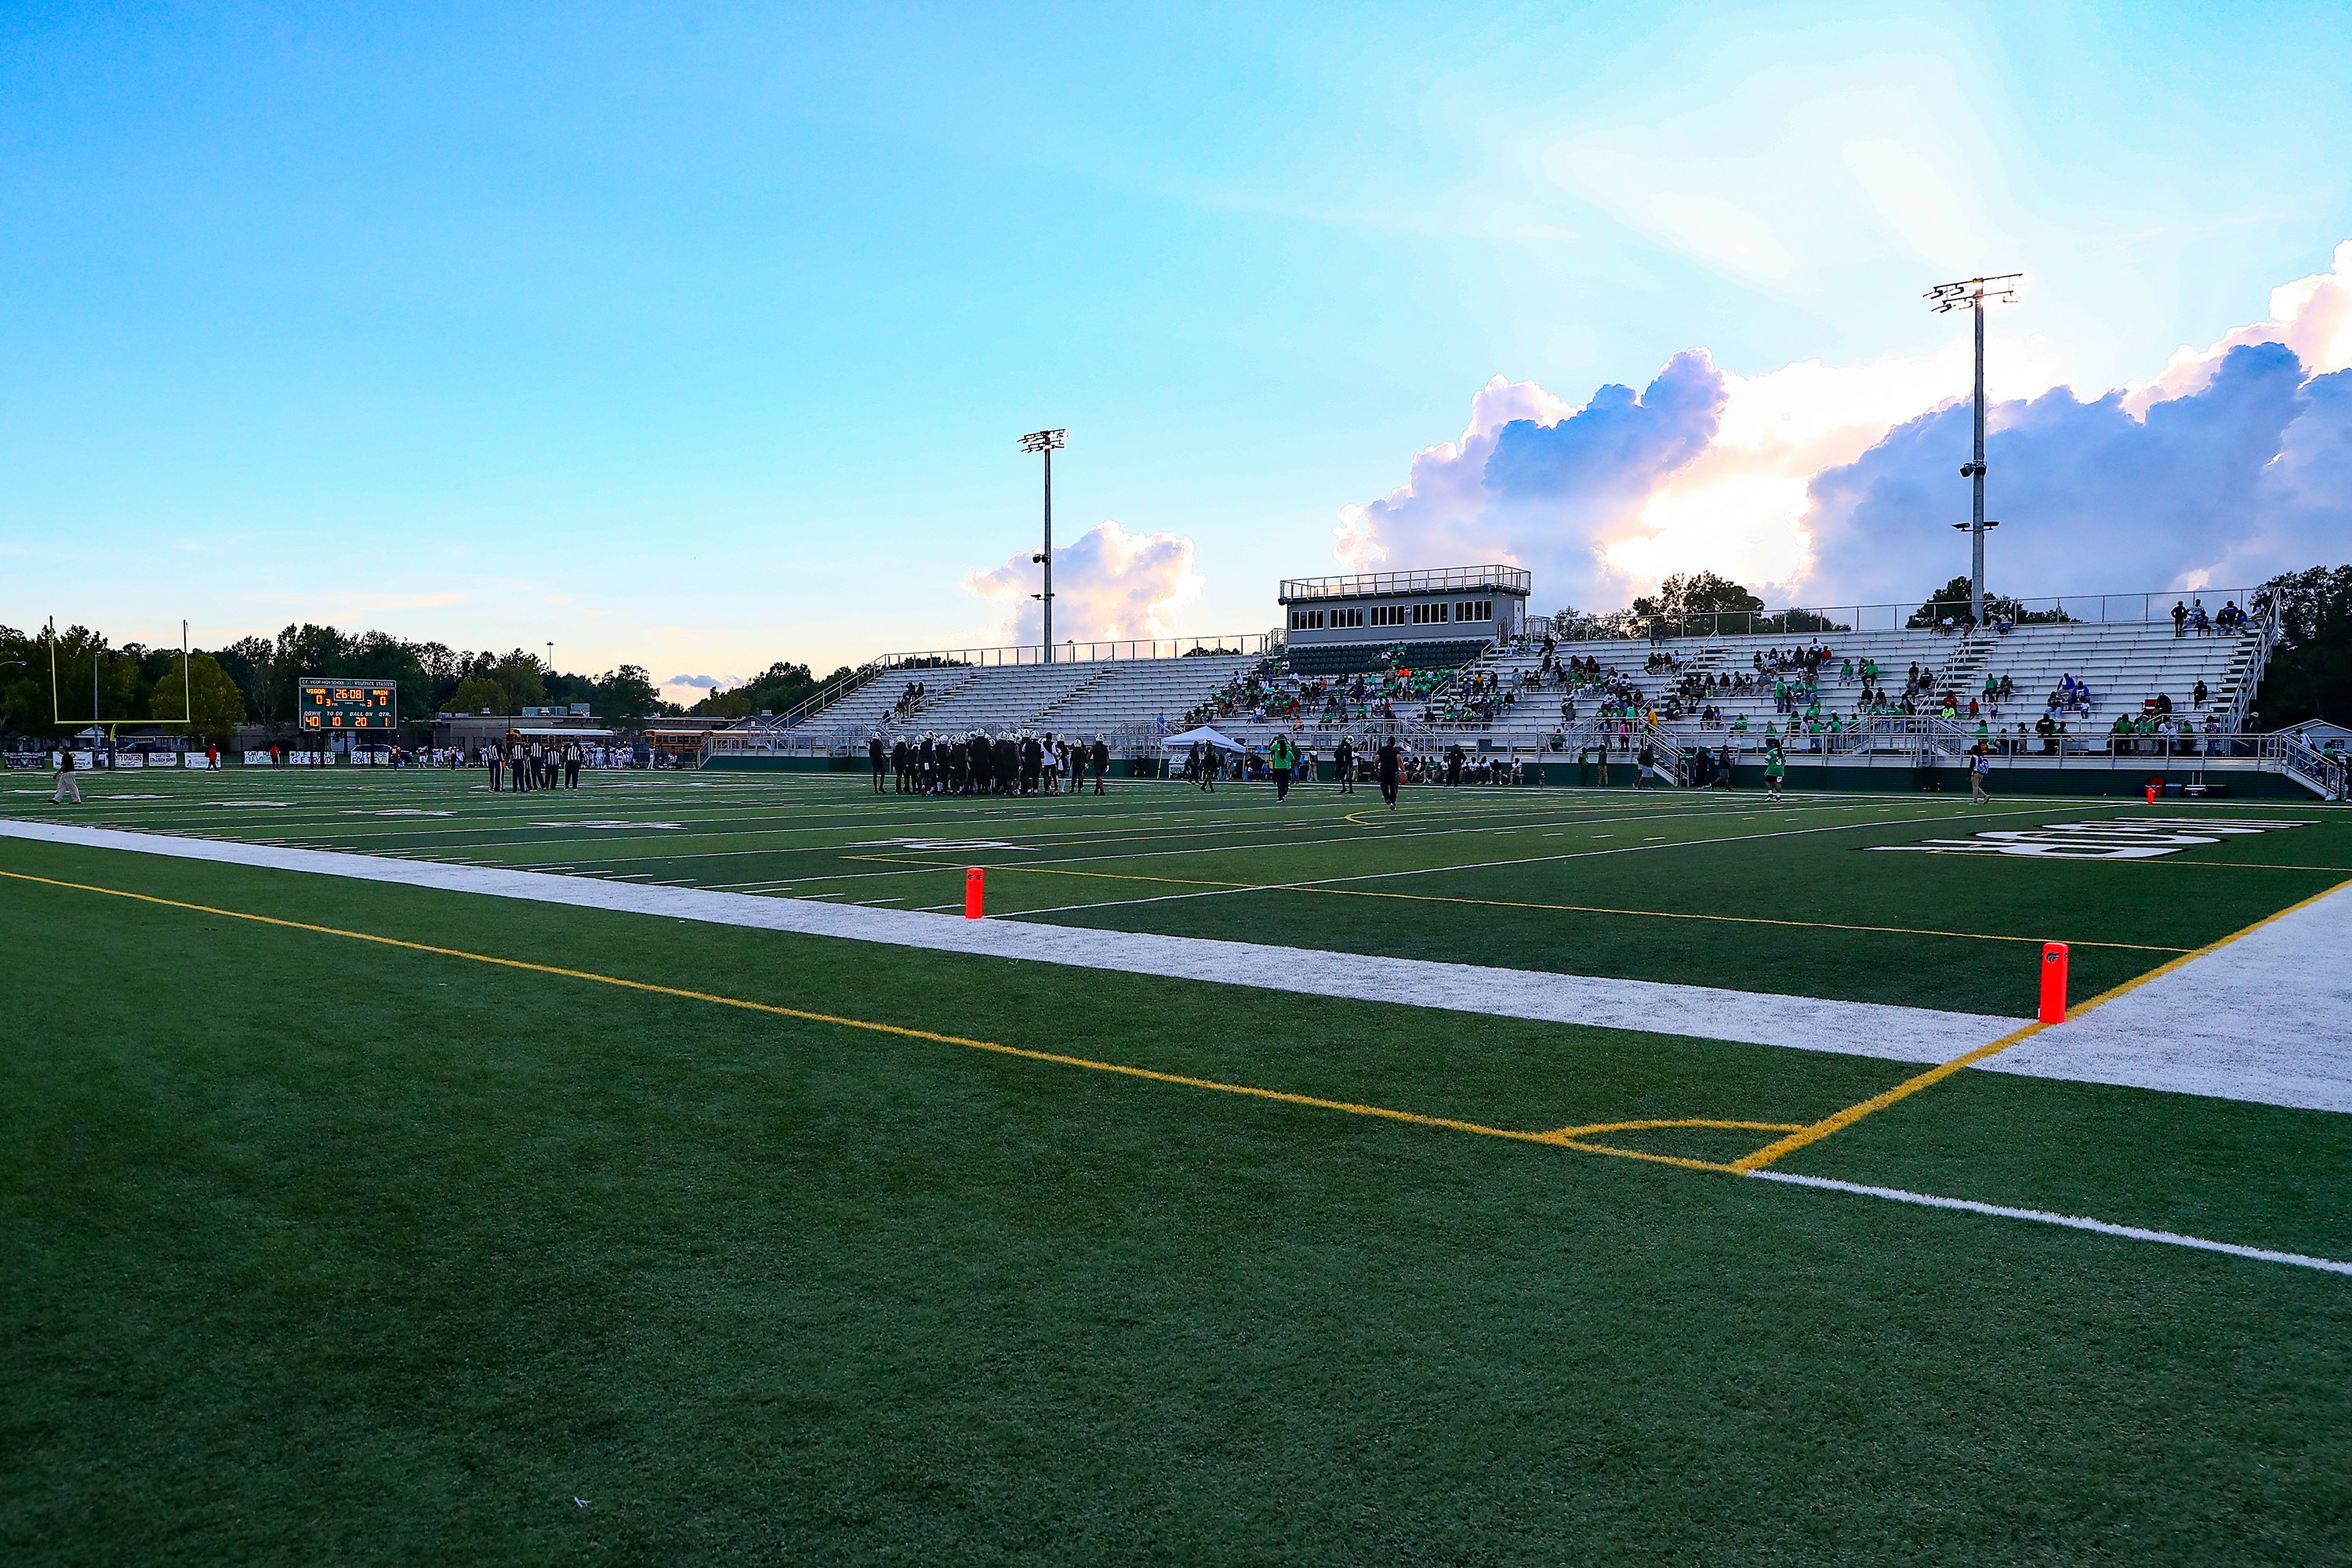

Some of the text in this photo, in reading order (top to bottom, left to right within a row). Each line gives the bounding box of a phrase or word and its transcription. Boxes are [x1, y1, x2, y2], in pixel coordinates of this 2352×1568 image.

[336, 689, 362, 699] 26:08
[316, 695, 323, 705] 0
[325, 699, 332, 707] 3
[379, 696, 387, 706] 0
[305, 716, 320, 727] 40
[332, 717, 342, 726] 10
[354, 717, 368, 726] 20
